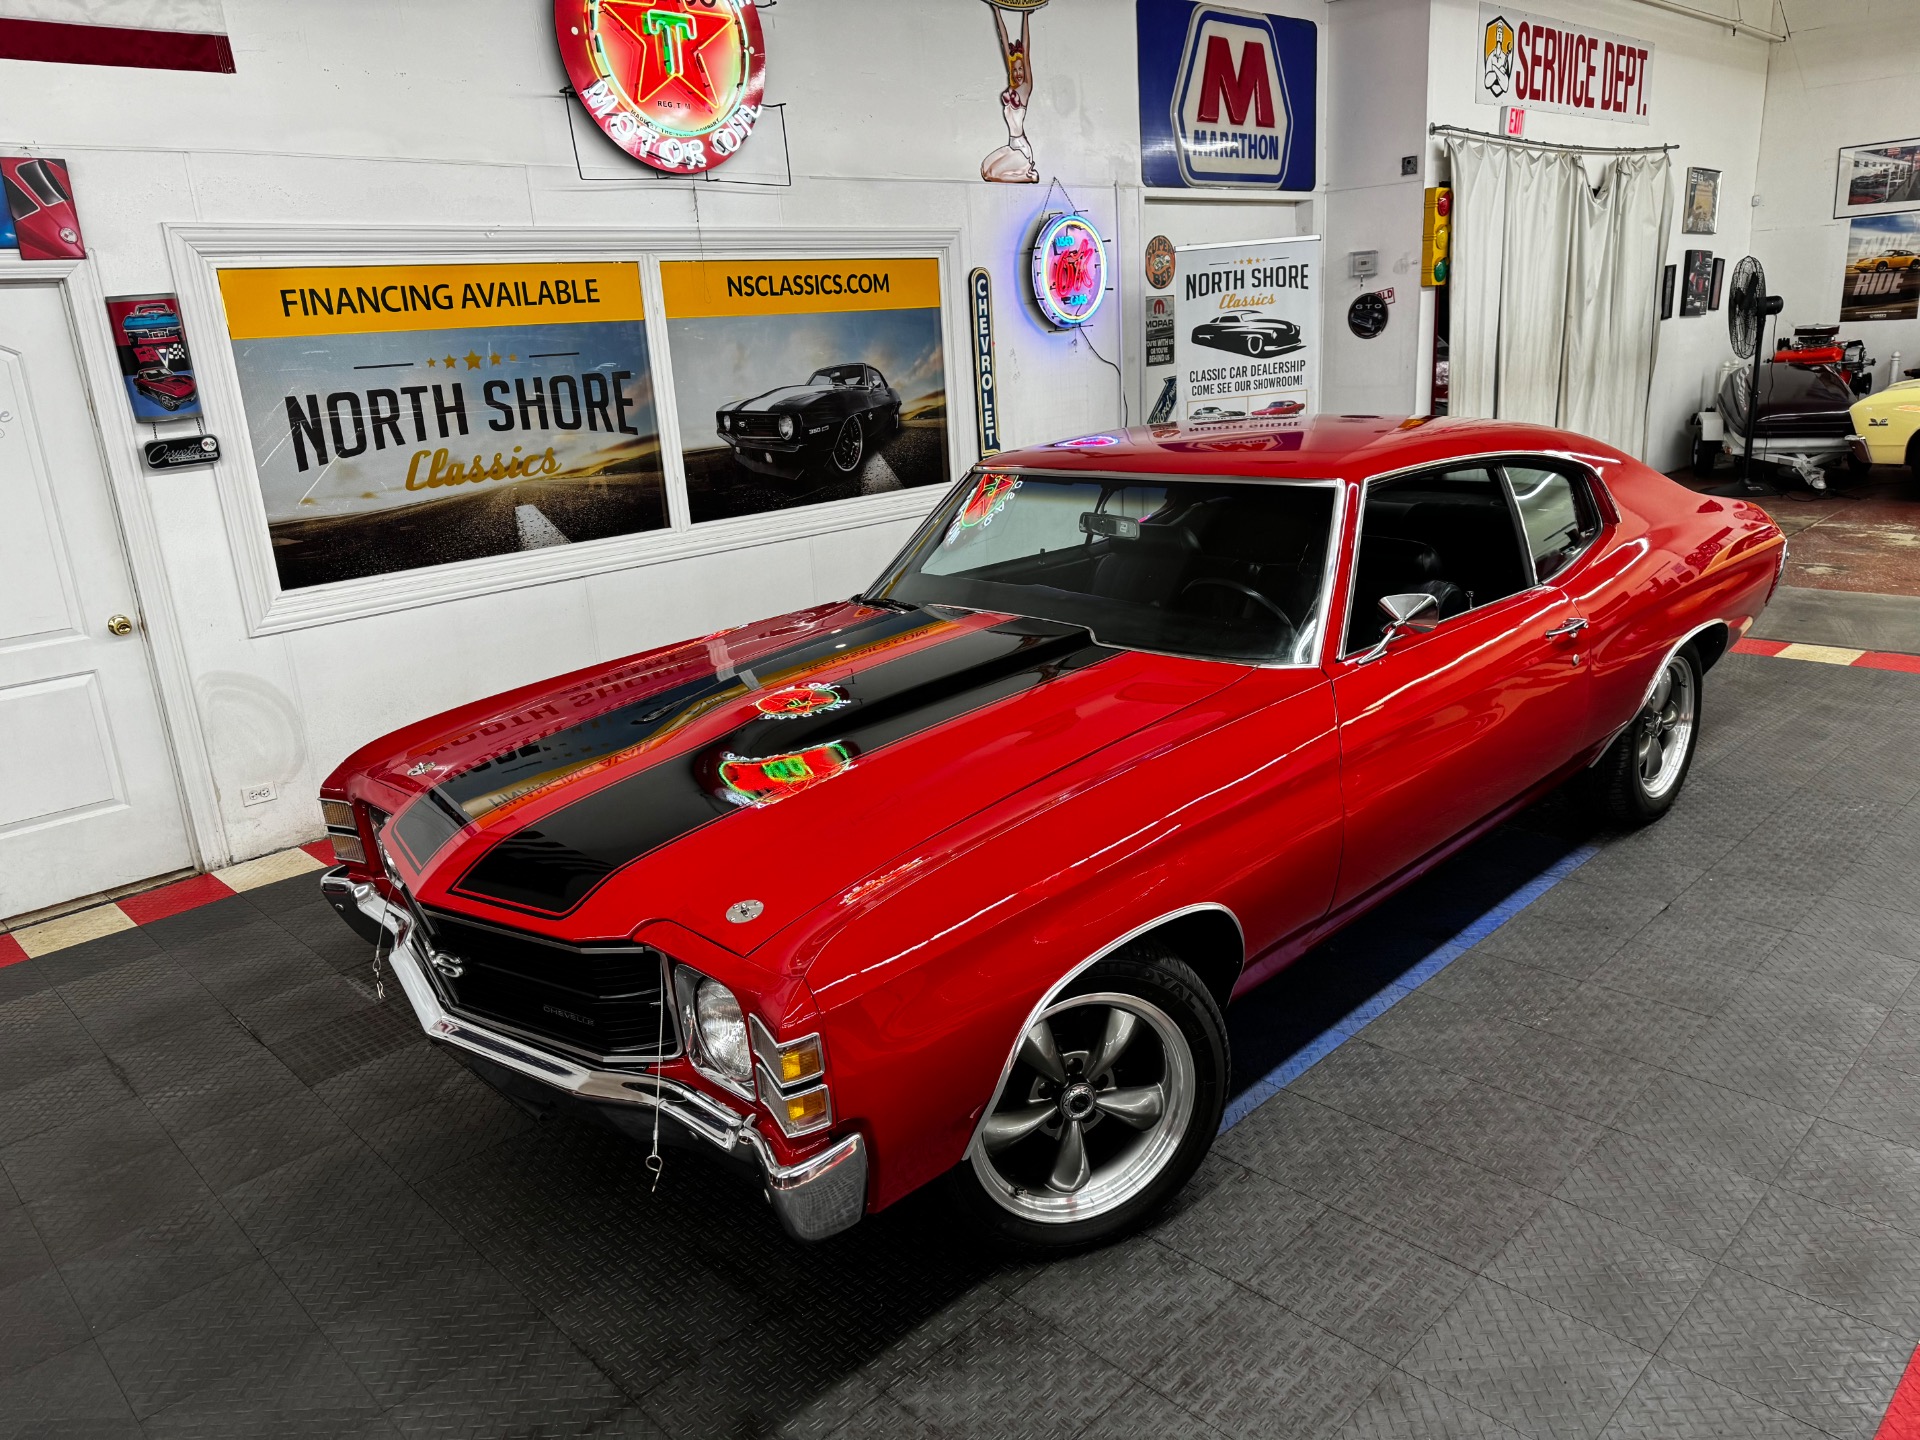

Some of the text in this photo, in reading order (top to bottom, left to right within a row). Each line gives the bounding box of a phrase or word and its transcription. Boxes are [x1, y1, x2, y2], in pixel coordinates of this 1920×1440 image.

[1197, 35, 1275, 128] M
[1515, 21, 1648, 116] SERVICE DEPT.
[581, 79, 762, 169] MOTOR OIL
[1508, 107, 1525, 135] EXIT
[1193, 130, 1279, 160] MARATHON
[727, 273, 890, 297] NSCLASSICS.COM
[1186, 263, 1309, 301] NORTH SHORE
[1853, 272, 1904, 296] RIDE
[279, 278, 601, 317] FINANCING AVAILABLE
[1218, 293, 1276, 310] Classics
[1146, 319, 1174, 328] MOPAR
[976, 278, 995, 447] CHEVROLET
[1189, 359, 1306, 383] CLASSIC CAR DEALERSHIP
[1191, 383, 1215, 397] COME
[1217, 381, 1232, 394] SEE
[1234, 380, 1251, 392] OUR
[1253, 374, 1303, 390] SHOWROOM!
[284, 370, 639, 473] NORTH SHORE
[148, 443, 205, 465] Corvette
[405, 445, 562, 491] Classics
[543, 1005, 595, 1027] CHEVELLE
